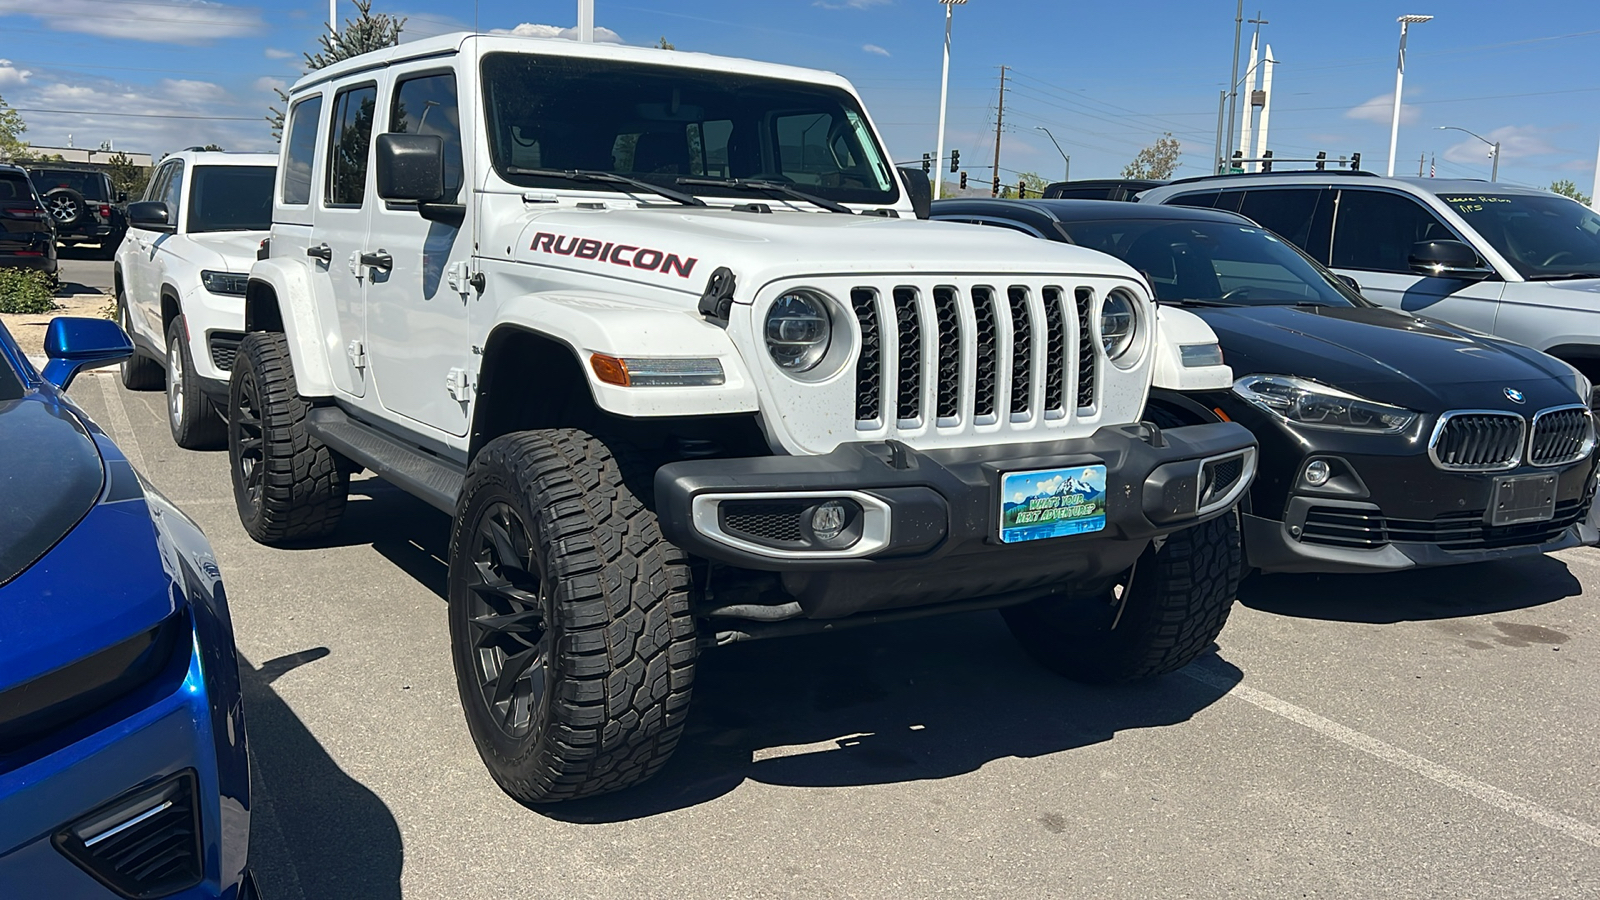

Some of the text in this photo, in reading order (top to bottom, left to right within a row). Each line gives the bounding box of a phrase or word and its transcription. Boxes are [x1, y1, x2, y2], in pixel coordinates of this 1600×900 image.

[529, 231, 699, 279] RUBICON
[1029, 493, 1085, 511] WHAT'S YOUR
[1015, 503, 1096, 524] NEXT ADVENTURE?
